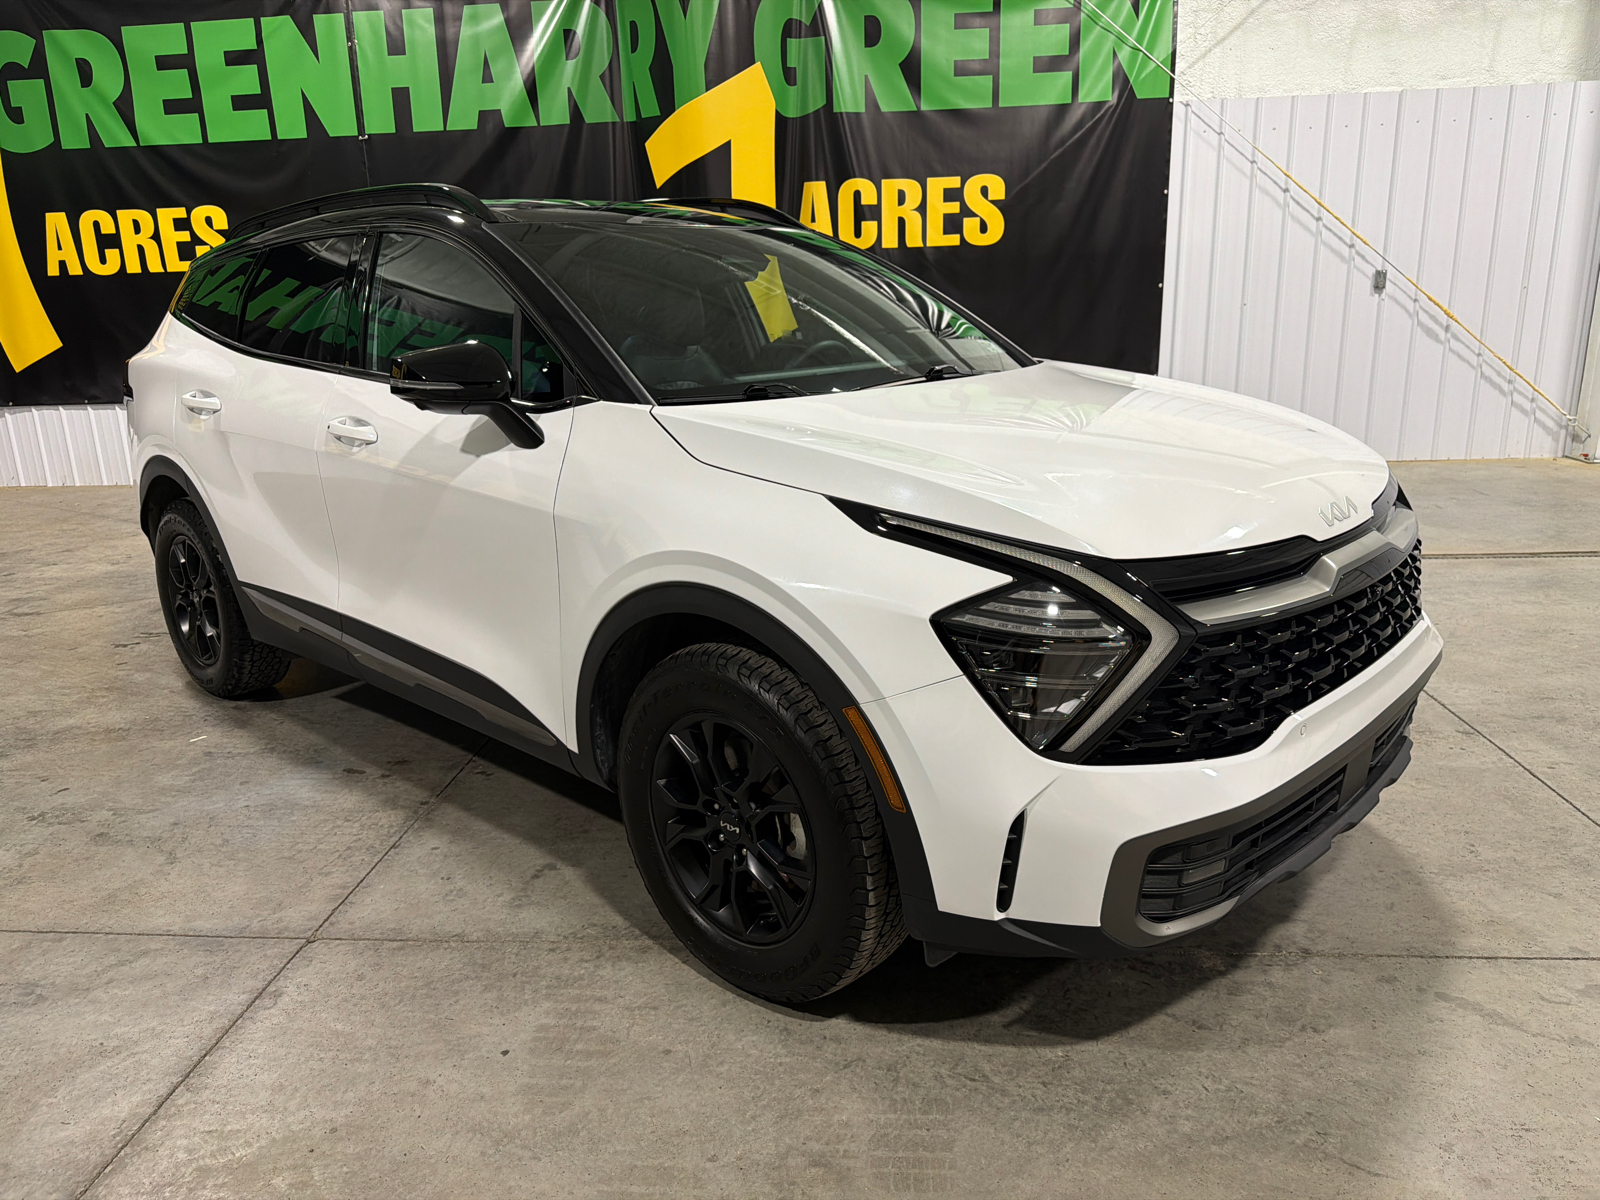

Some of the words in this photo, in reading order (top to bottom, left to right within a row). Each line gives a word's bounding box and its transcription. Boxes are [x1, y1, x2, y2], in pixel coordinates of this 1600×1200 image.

[0, 13, 358, 153] GREEN
[352, 0, 720, 134] HARRY
[753, 0, 1173, 118] GREEN
[45, 205, 229, 276] ACRES
[799, 173, 1006, 250] ACRES
